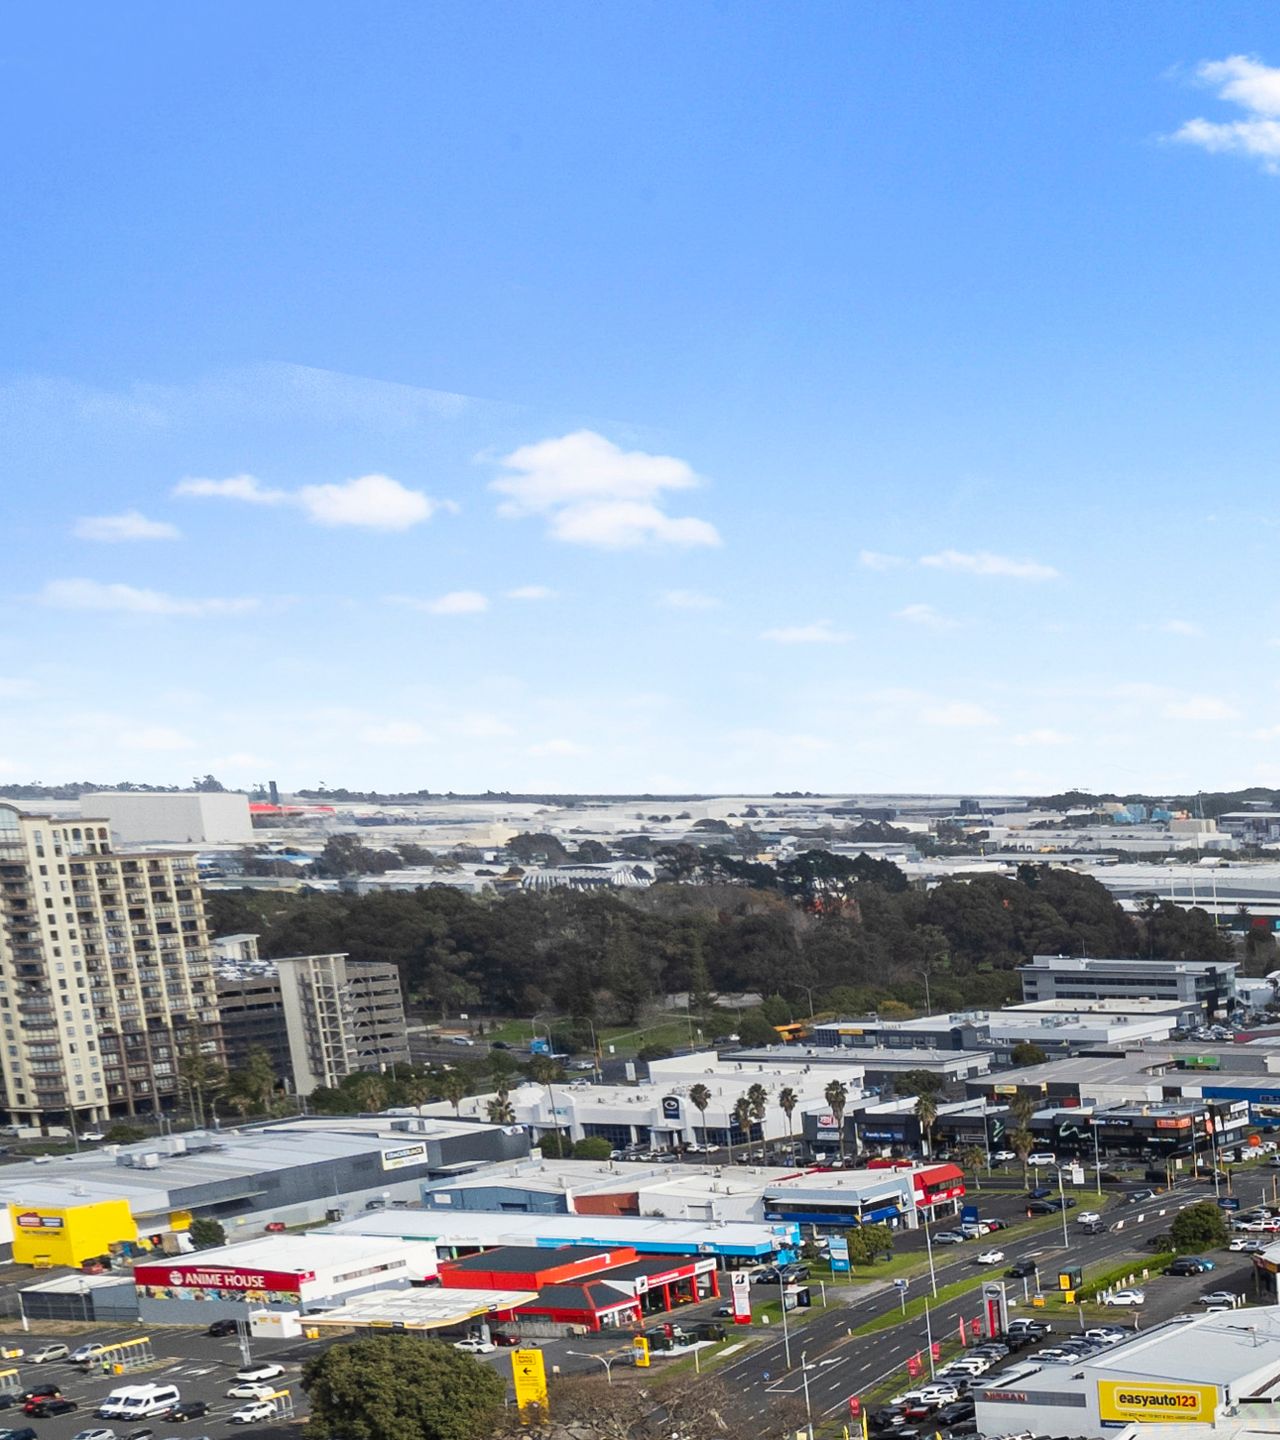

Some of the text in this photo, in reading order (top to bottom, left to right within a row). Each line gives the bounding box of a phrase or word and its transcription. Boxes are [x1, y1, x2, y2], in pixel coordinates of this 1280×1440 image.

[185, 1272, 265, 1287] ANIME HOUSE
[1119, 1393, 1197, 1408] easyauto123
